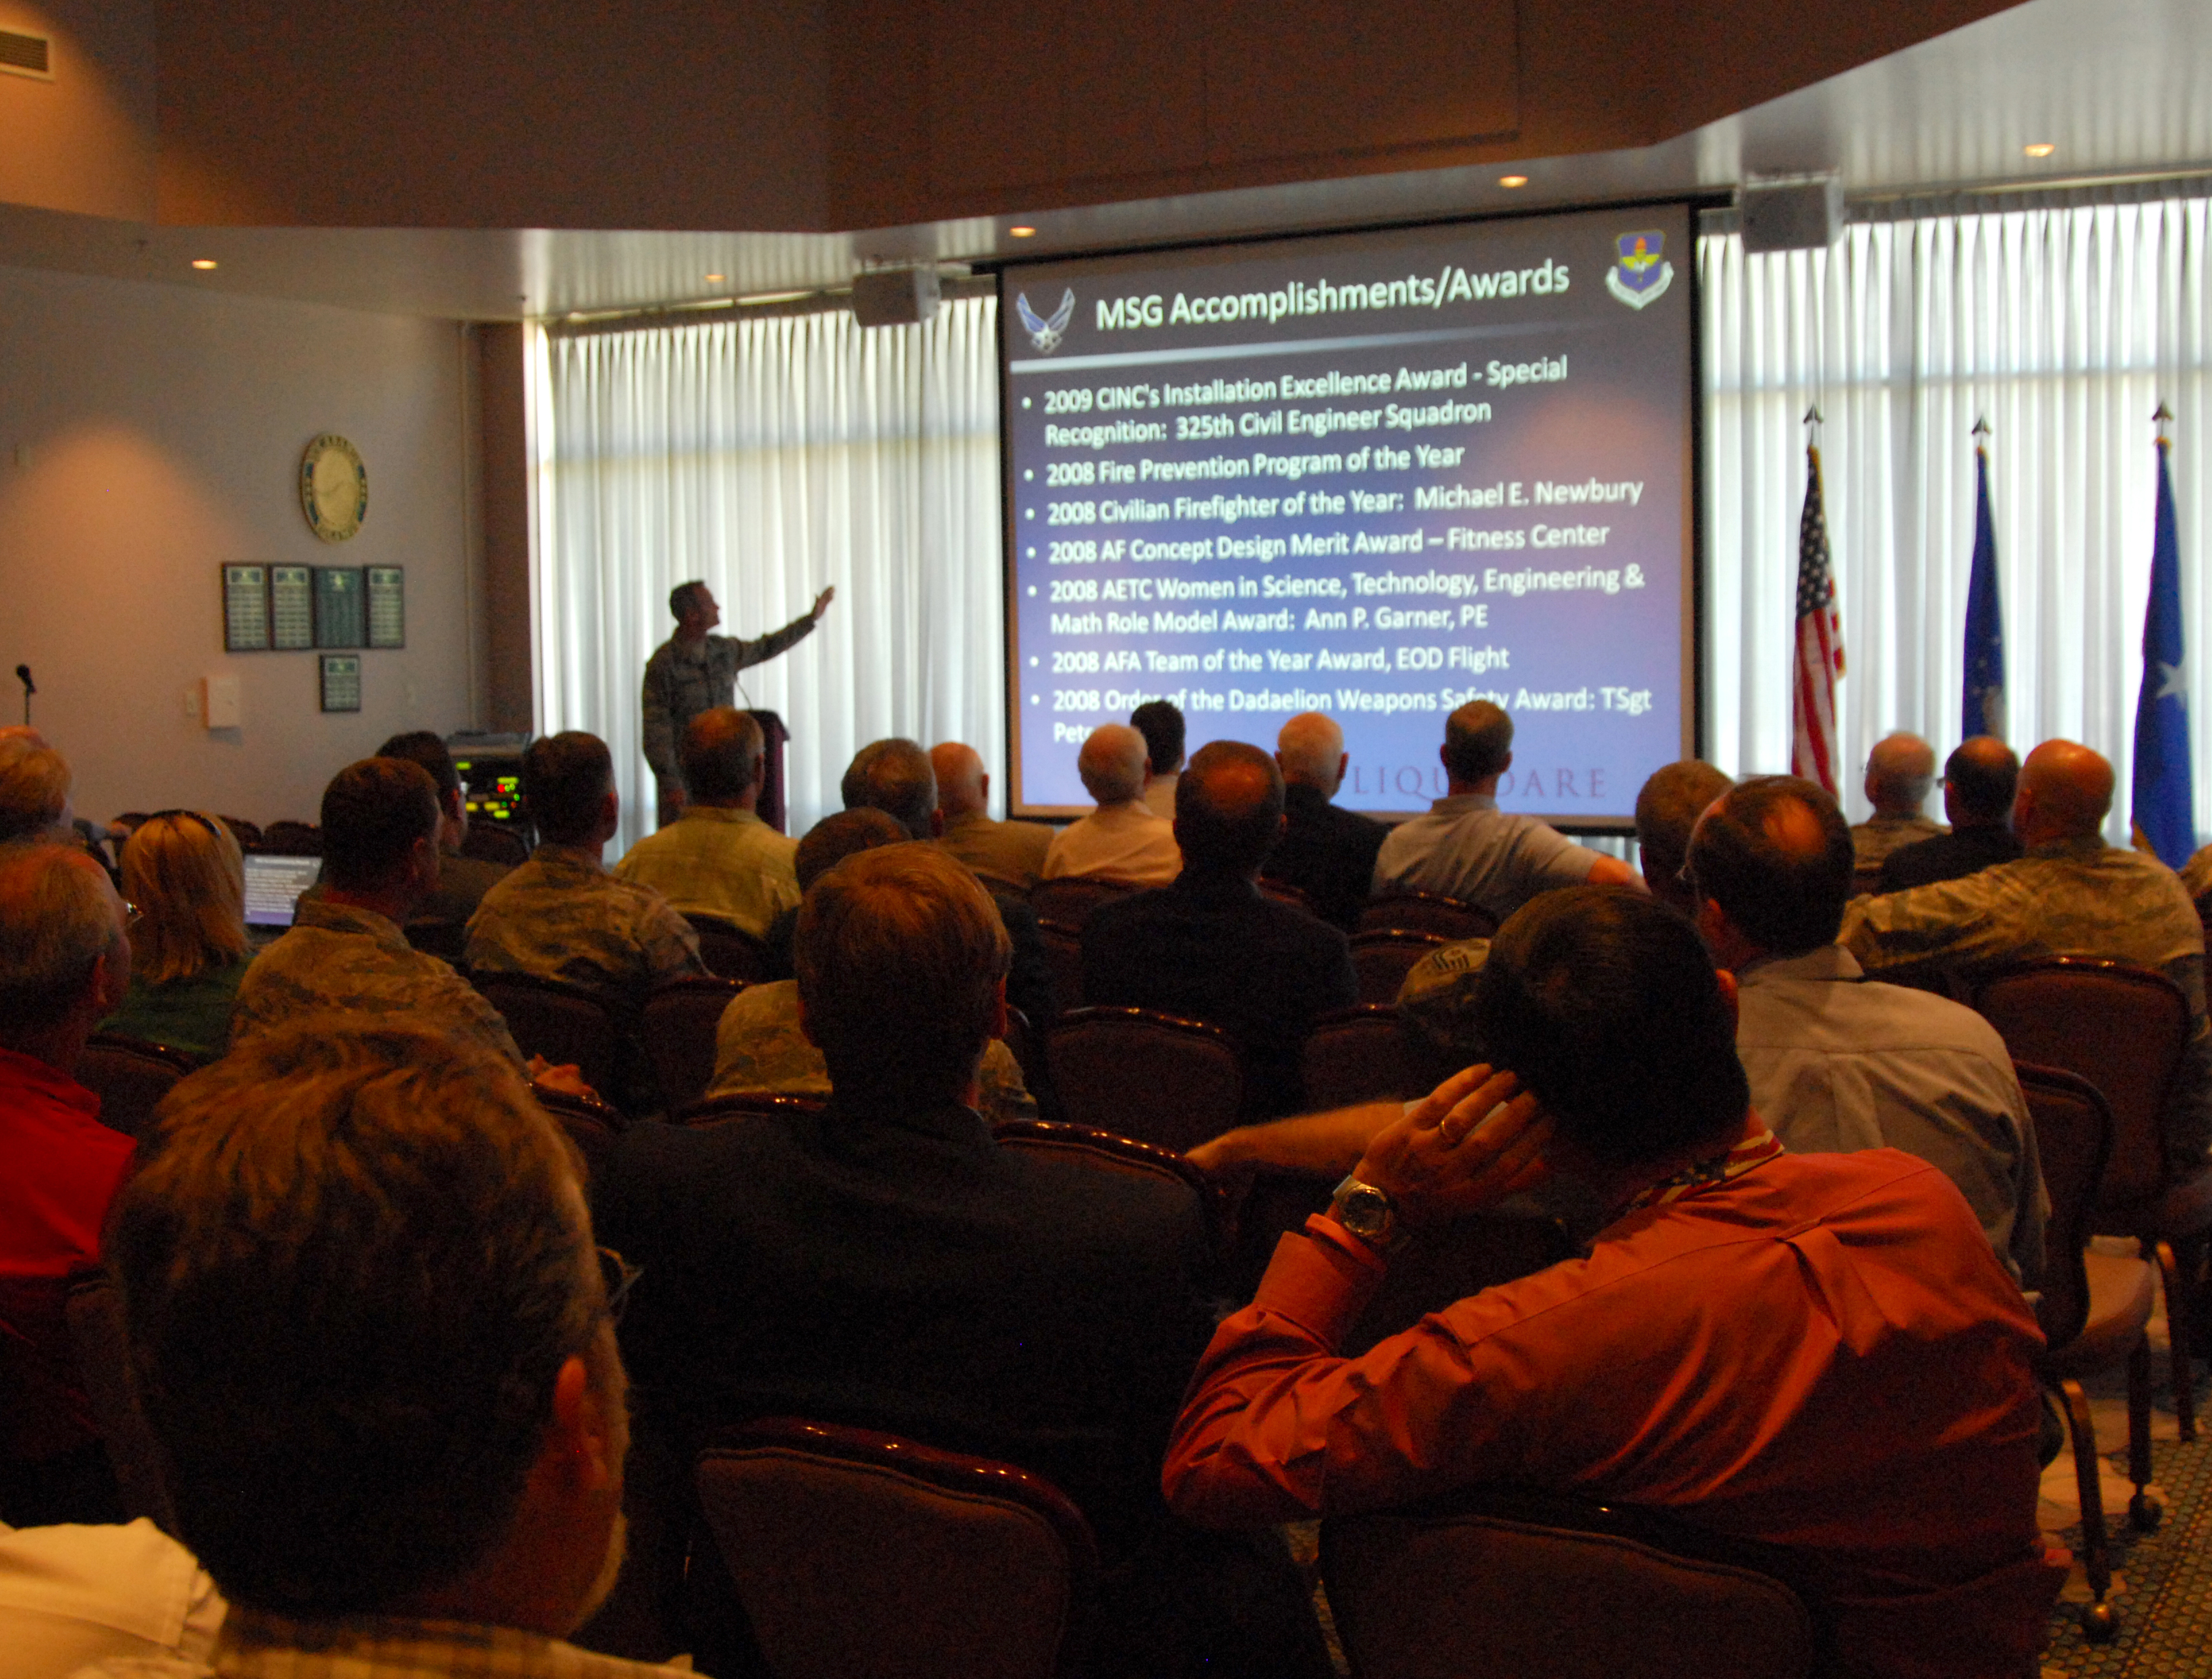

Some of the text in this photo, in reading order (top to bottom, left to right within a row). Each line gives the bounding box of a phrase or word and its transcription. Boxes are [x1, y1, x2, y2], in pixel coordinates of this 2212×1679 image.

[1096, 295, 1163, 330] MSG
[1169, 258, 1570, 323] Accomplishments/Awards
[1044, 388, 1092, 414] 2009
[1096, 384, 1160, 411] CINC's
[1164, 379, 1276, 406] Installation
[1280, 372, 1391, 401] Excellence
[1395, 362, 1467, 390] Award
[1486, 355, 1568, 390] Special
[1045, 399, 1492, 449] Recognition: 325th Civil Engineer Squadron
[1046, 445, 1465, 486] 2008 Fire Prevention Program of the Year
[1047, 477, 1643, 525] 2008 Civilian Firefighter of the Year: Michael E. Newbury
[1049, 540, 1097, 564] 2008
[1100, 539, 1126, 561] AF
[1130, 539, 1213, 564] Concept
[1217, 535, 1287, 562] Design
[1290, 532, 1349, 557] Merit
[1354, 529, 1423, 554] Award
[1447, 526, 1525, 550] Fitness
[1531, 524, 1610, 548] Center
[1050, 564, 1645, 603] 2008 AETC Women in Science, Technology, Engineering &
[1051, 604, 1488, 635] Math Role Model Award: Ann P. Garner, PE
[1052, 645, 1509, 674] 2008 AFA Team of the Year Award, EOD Flight
[1053, 689, 1100, 711] 2008
[1165, 688, 1188, 710] of
[1191, 688, 1224, 711] the
[1228, 688, 1332, 711] Dadaelion
[1336, 688, 1437, 713] Weapons
[1515, 686, 1595, 709] Award:
[1600, 687, 1652, 716] TSgt
[1353, 765, 1606, 802] LIQUDARE
